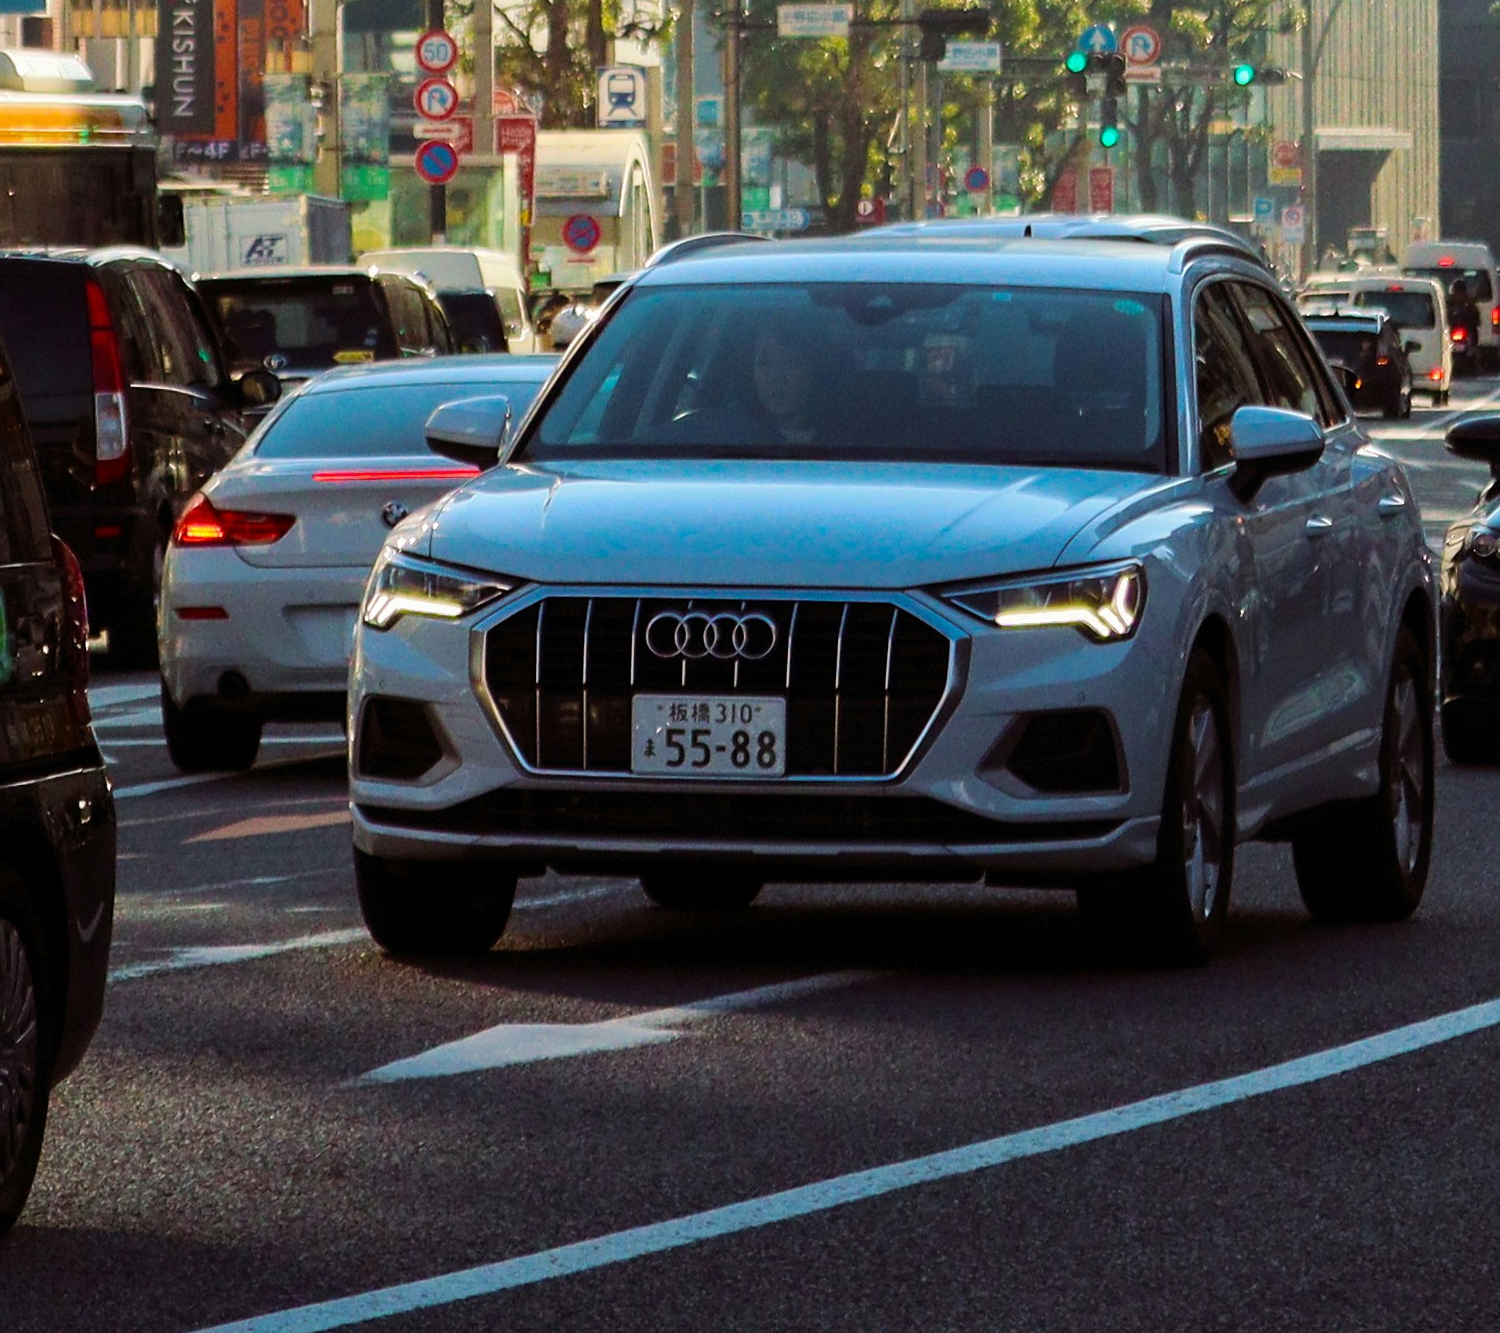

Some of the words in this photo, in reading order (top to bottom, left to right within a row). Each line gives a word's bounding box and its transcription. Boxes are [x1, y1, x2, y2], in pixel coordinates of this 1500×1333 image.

[172, 9, 196, 119] KISHUN
[423, 41, 449, 63] 50
[668, 703, 711, 723] 板橋
[715, 703, 753, 724] 310
[642, 736, 658, 758] ま
[664, 728, 777, 770] 55-88
